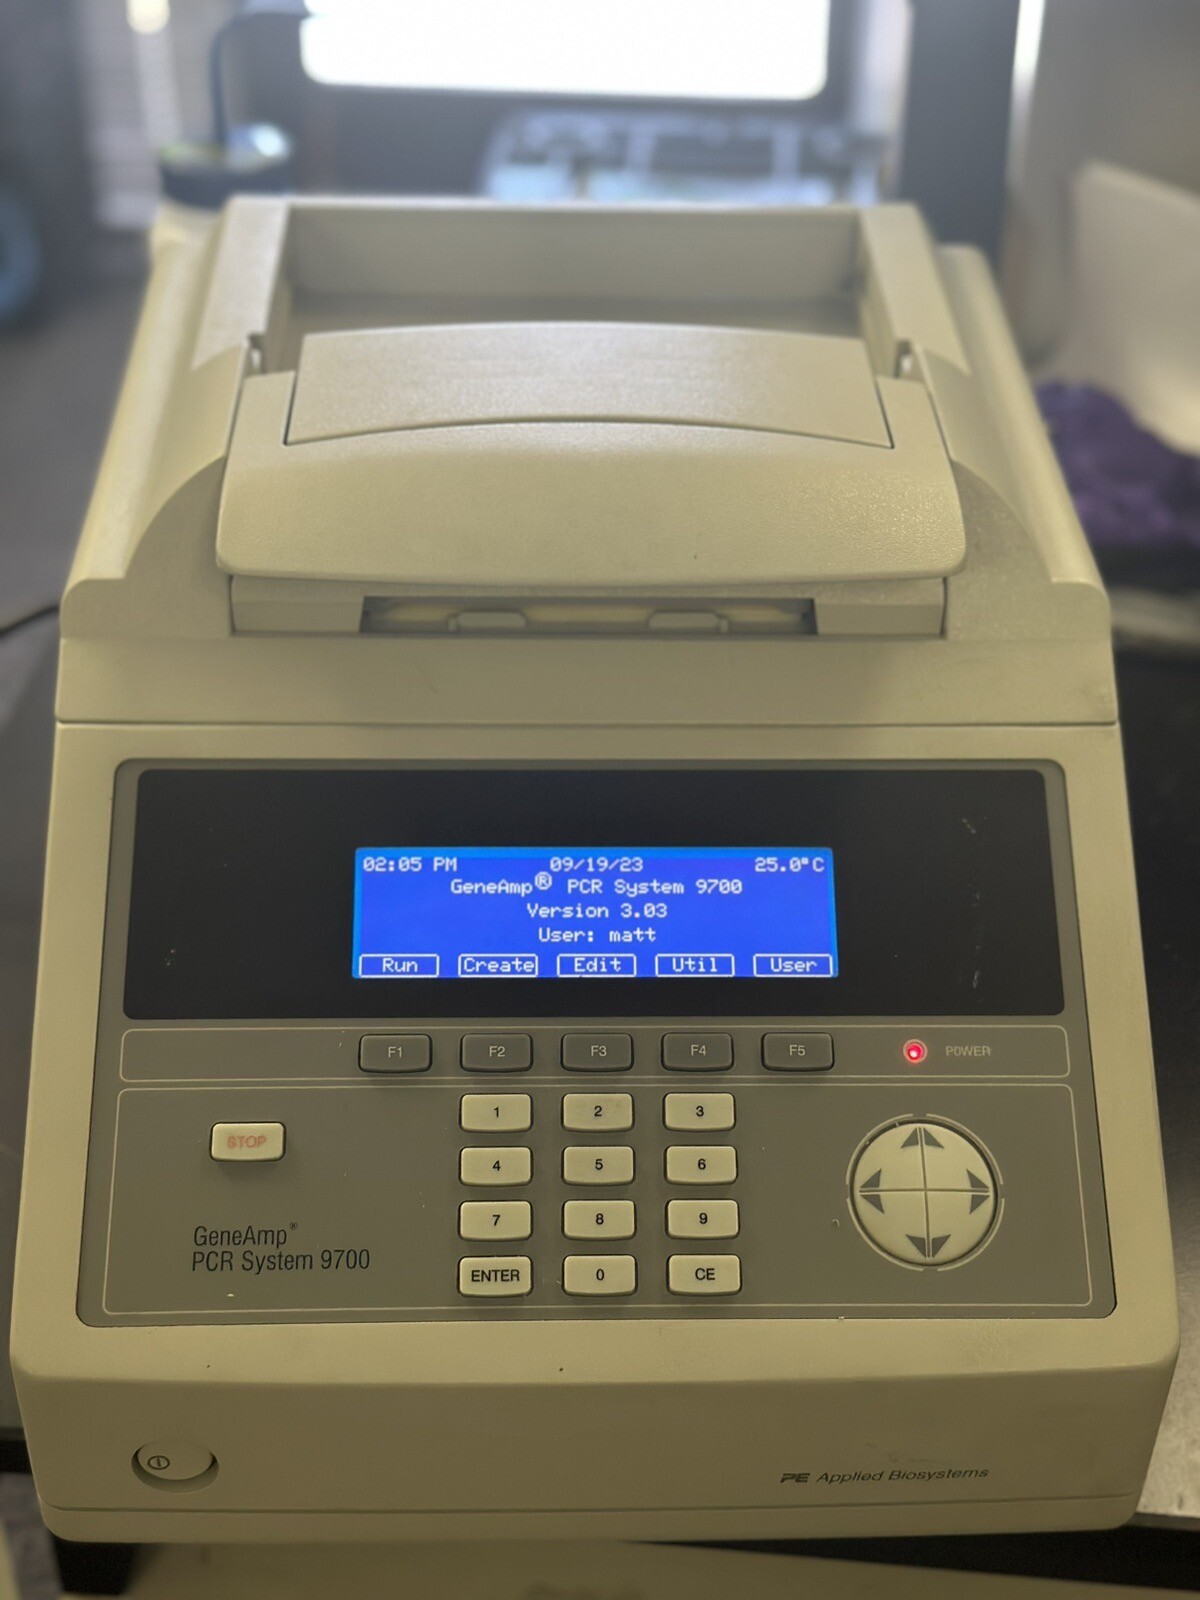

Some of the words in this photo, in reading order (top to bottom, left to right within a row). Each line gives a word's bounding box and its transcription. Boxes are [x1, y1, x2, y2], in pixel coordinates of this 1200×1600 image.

[433, 857, 458, 873] PM
[549, 857, 644, 873] 09/19/23
[567, 878, 604, 895] PCR
[613, 878, 685, 898] System
[695, 878, 743, 895] 9700
[526, 902, 609, 918] Version
[620, 902, 668, 918] 3.03
[538, 926, 595, 943] User:
[608, 926, 657, 943] matt
[381, 957, 419, 973] Run
[463, 957, 535, 973] Create
[573, 957, 622, 973] Edit
[671, 957, 718, 973] Util
[770, 957, 817, 973] User
[387, 1044, 404, 1060] F1
[488, 1043, 506, 1059] F2
[590, 1043, 607, 1059] F3
[690, 1042, 707, 1058] F4
[789, 1042, 806, 1058] F5
[945, 1044, 992, 1058] POWER
[493, 1105, 501, 1119] 1
[593, 1105, 603, 1119] 2
[695, 1104, 705, 1118] 3
[226, 1134, 268, 1149] STOP
[492, 1158, 502, 1172] 4
[594, 1157, 604, 1172] 5
[697, 1157, 707, 1171] 6
[492, 1213, 501, 1227] 7
[595, 1211, 605, 1226] 8
[699, 1211, 708, 1226] 9
[191, 1251, 234, 1272] PCR
[241, 1251, 313, 1274] System
[320, 1249, 370, 1270] 9700
[470, 1268, 521, 1284] ENTER
[694, 1266, 717, 1282] CE
[780, 1472, 811, 1483] PE
[816, 1471, 884, 1485] Applied
[888, 1467, 989, 1481] Biosystems
